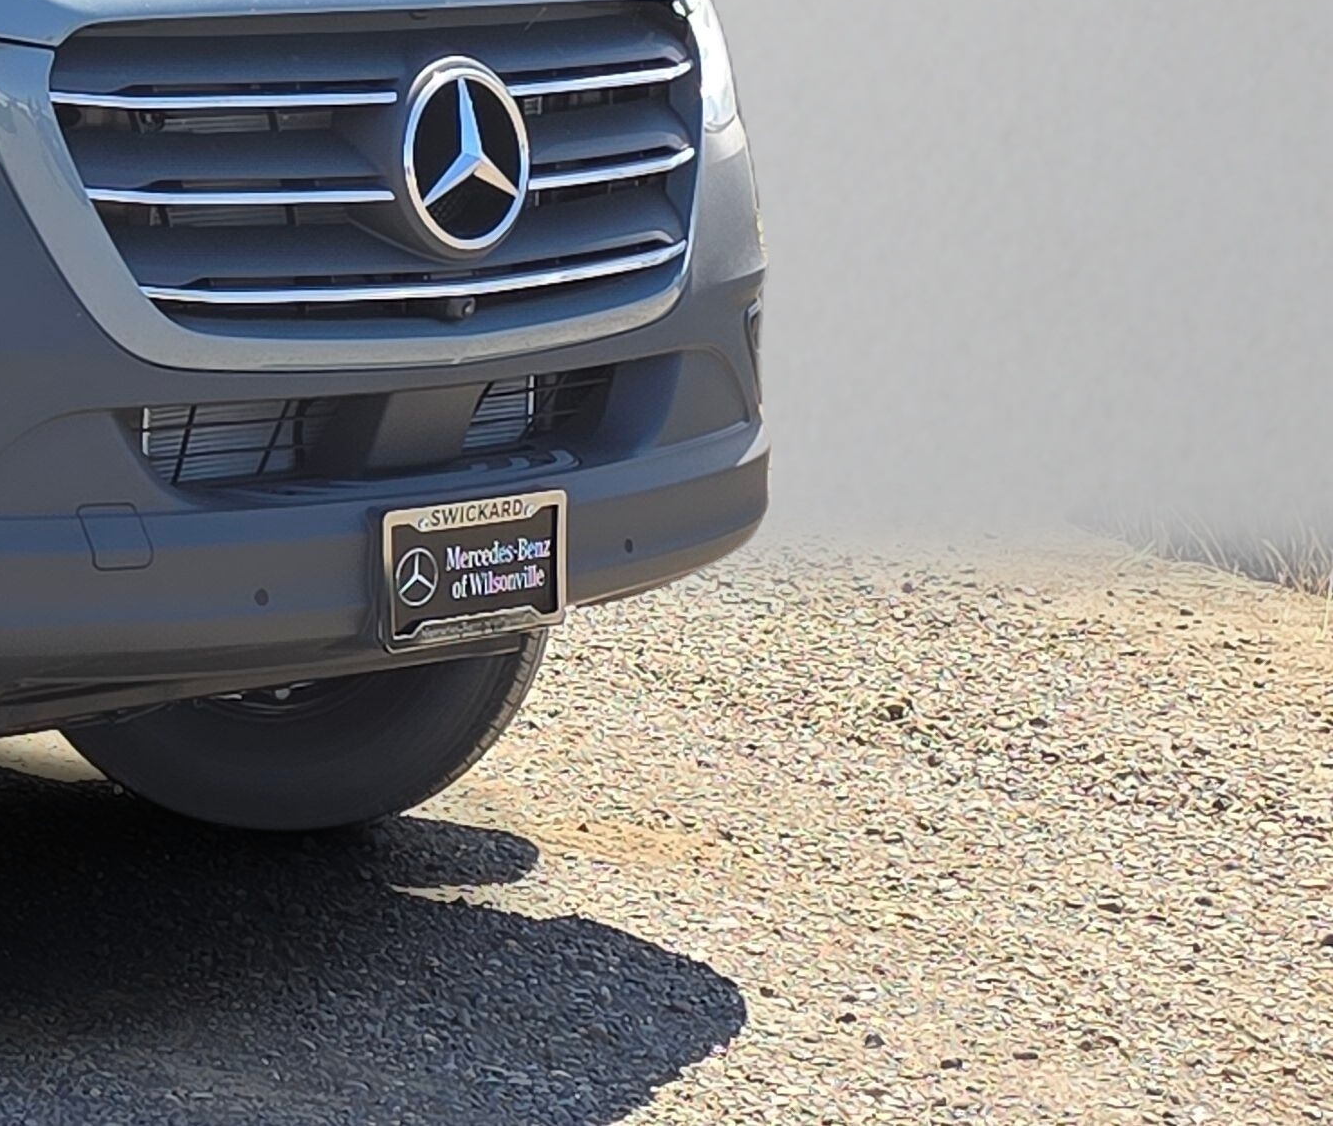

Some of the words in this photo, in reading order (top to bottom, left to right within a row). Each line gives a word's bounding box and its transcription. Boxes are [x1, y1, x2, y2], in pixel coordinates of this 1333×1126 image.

[431, 499, 523, 527] SWICKARD
[445, 537, 551, 571] Mercedes-Benz
[452, 573, 468, 599] of
[469, 565, 545, 596] Wilsonville
